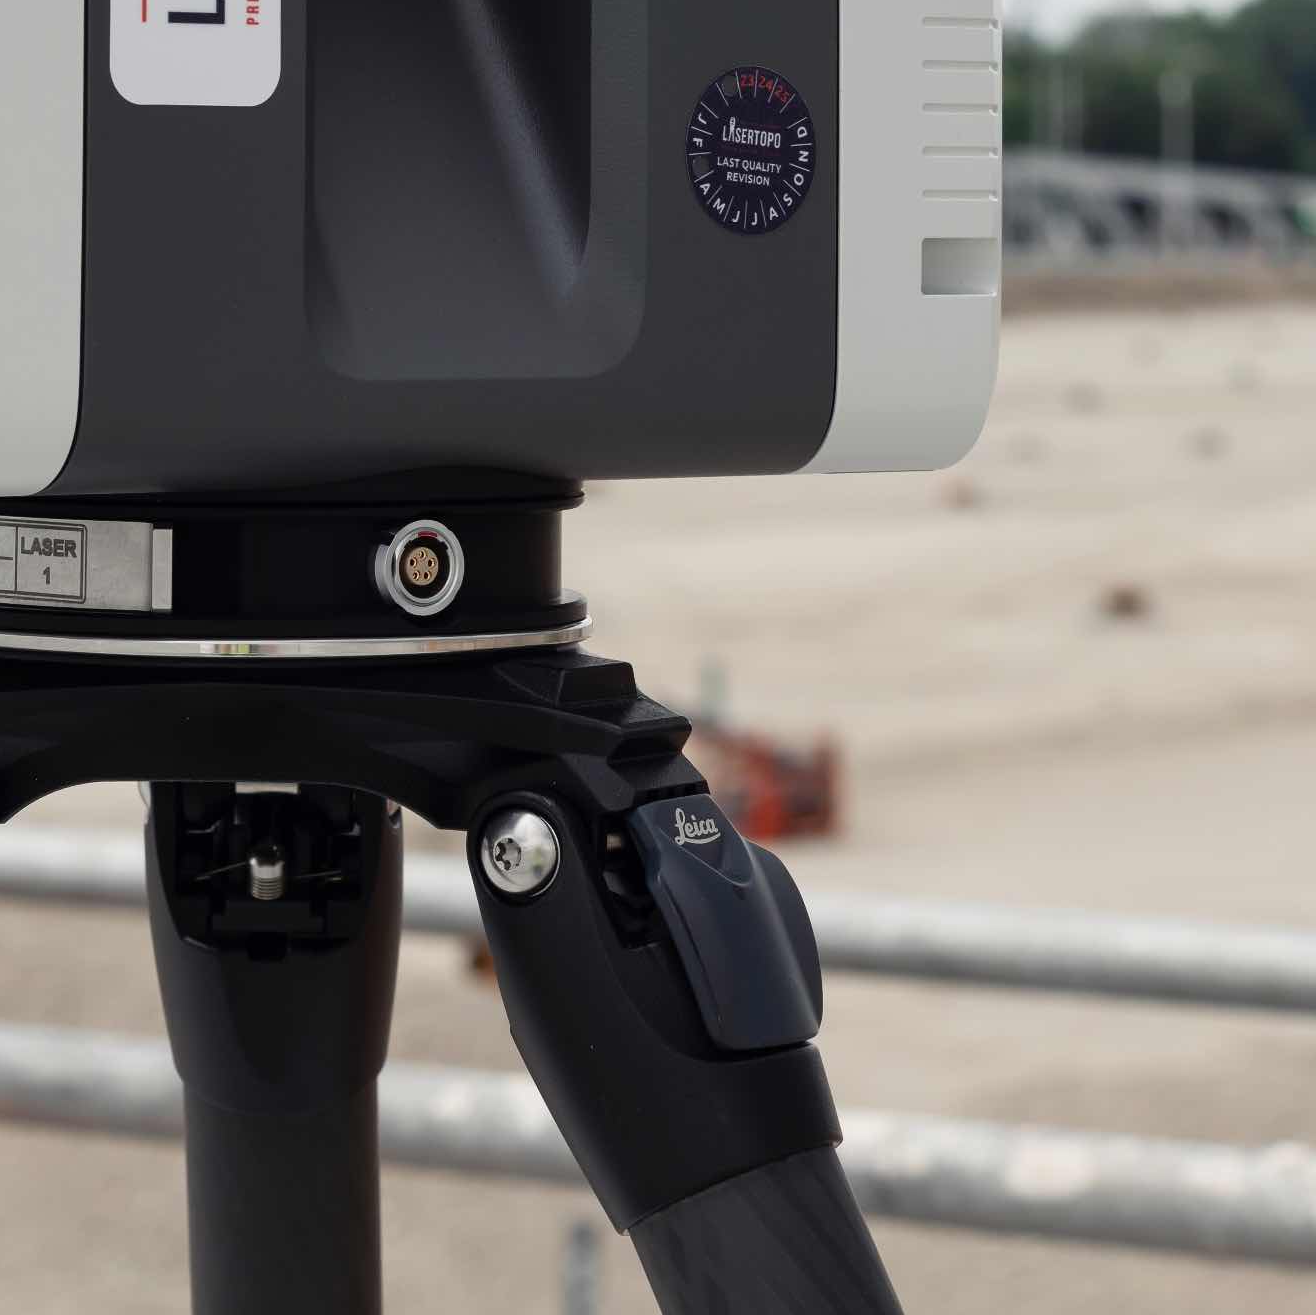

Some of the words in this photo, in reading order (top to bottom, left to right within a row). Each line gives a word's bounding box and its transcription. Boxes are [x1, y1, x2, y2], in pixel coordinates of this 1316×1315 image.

[722, 124, 781, 149] LASERTOPO
[797, 126, 808, 139] D
[692, 137, 704, 149] F
[798, 150, 809, 163] N
[717, 156, 741, 168] LAST
[741, 159, 782, 173] QUALITY
[726, 171, 770, 186] REVISION
[793, 173, 805, 186] O
[699, 182, 711, 196] A
[712, 197, 727, 215] M
[783, 192, 793, 207] S
[732, 210, 741, 223] J
[751, 212, 759, 226] J
[769, 206, 779, 220] A
[20, 536, 78, 559] LASER
[42, 566, 51, 585] 1
[674, 807, 721, 845] Leica
